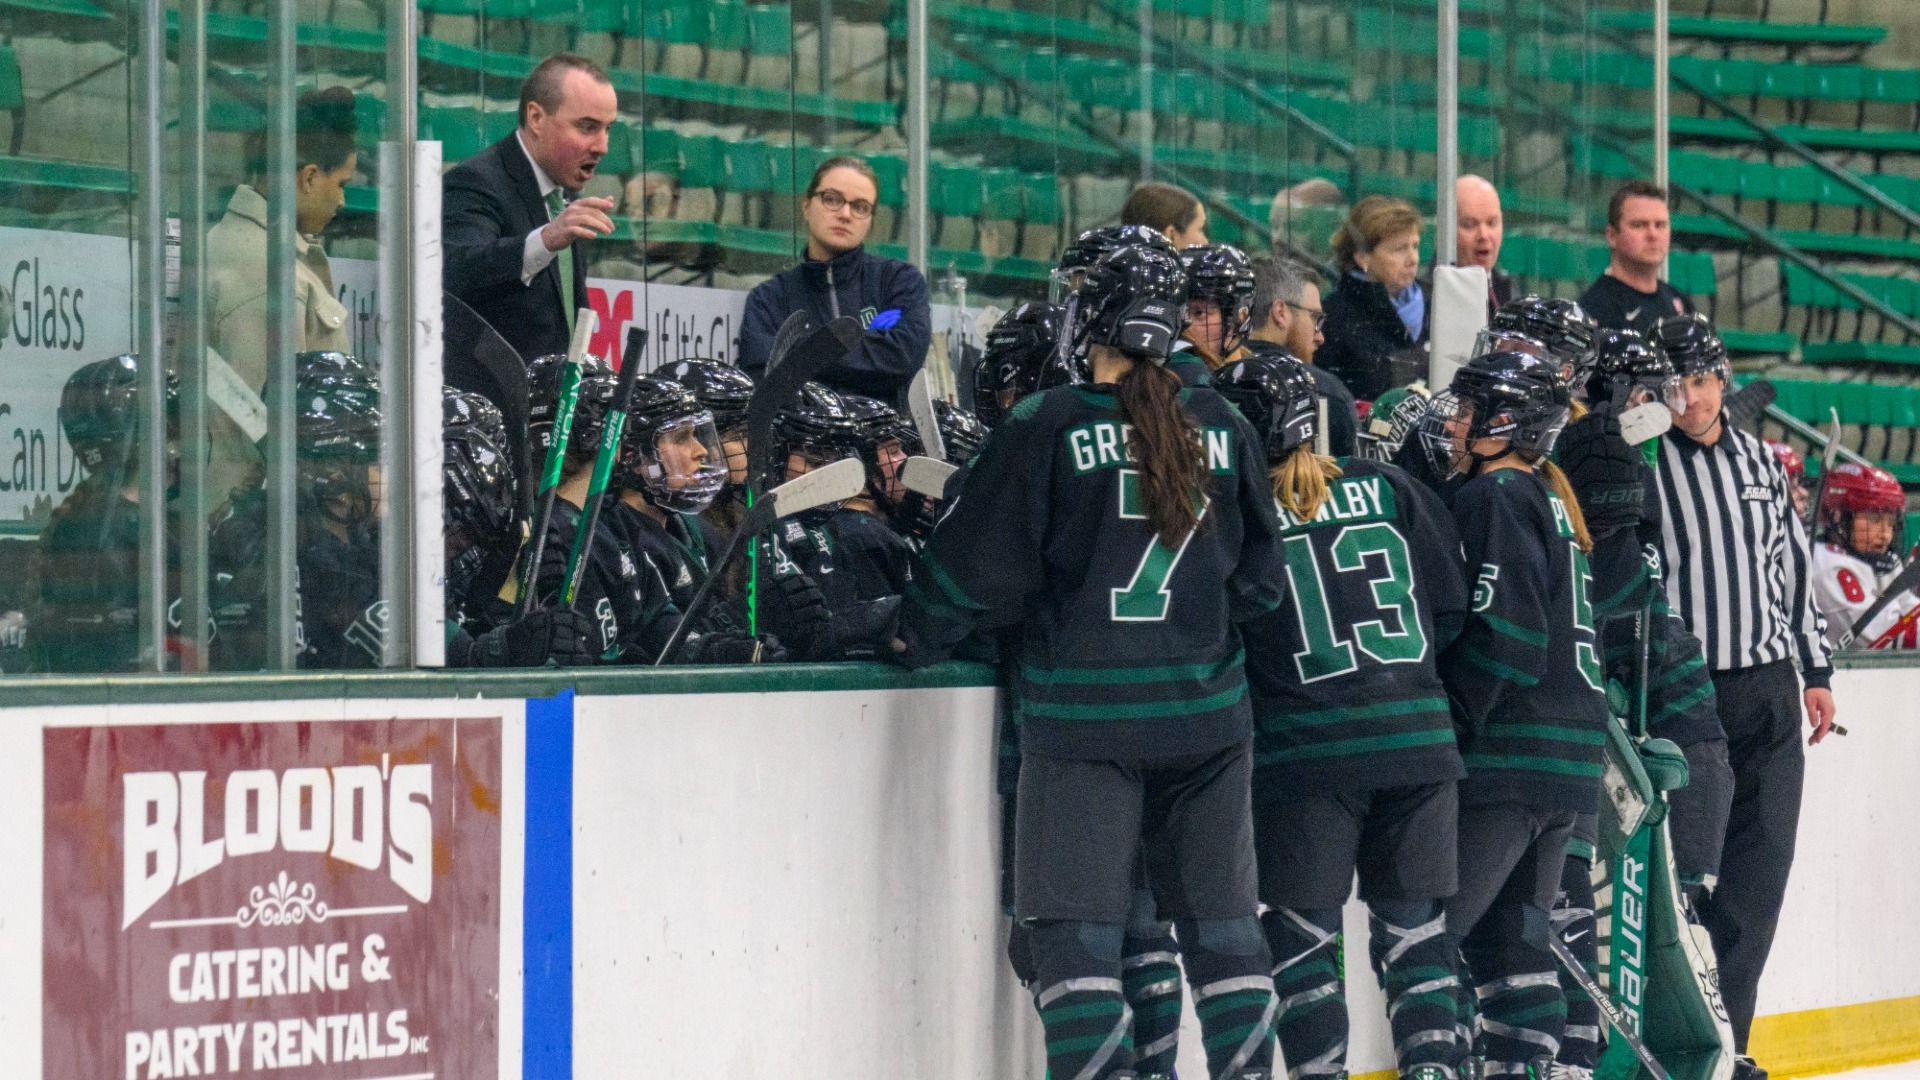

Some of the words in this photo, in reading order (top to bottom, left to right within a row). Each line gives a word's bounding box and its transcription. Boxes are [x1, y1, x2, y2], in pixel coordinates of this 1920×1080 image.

[12, 257, 84, 351] Glass
[1142, 333, 1152, 347] 7
[57, 407, 84, 492] D
[605, 410, 620, 449] AUER
[1300, 422, 1312, 439] 13
[1111, 469, 1211, 621] 7
[1282, 522, 1428, 684] 13
[122, 753, 432, 931] BLOOD'S
[169, 943, 349, 1003] CATERING
[361, 934, 391, 982] &
[126, 1022, 247, 1080] PARTY
[253, 1010, 409, 1071] RENTALS
[410, 1036, 429, 1054] INC
